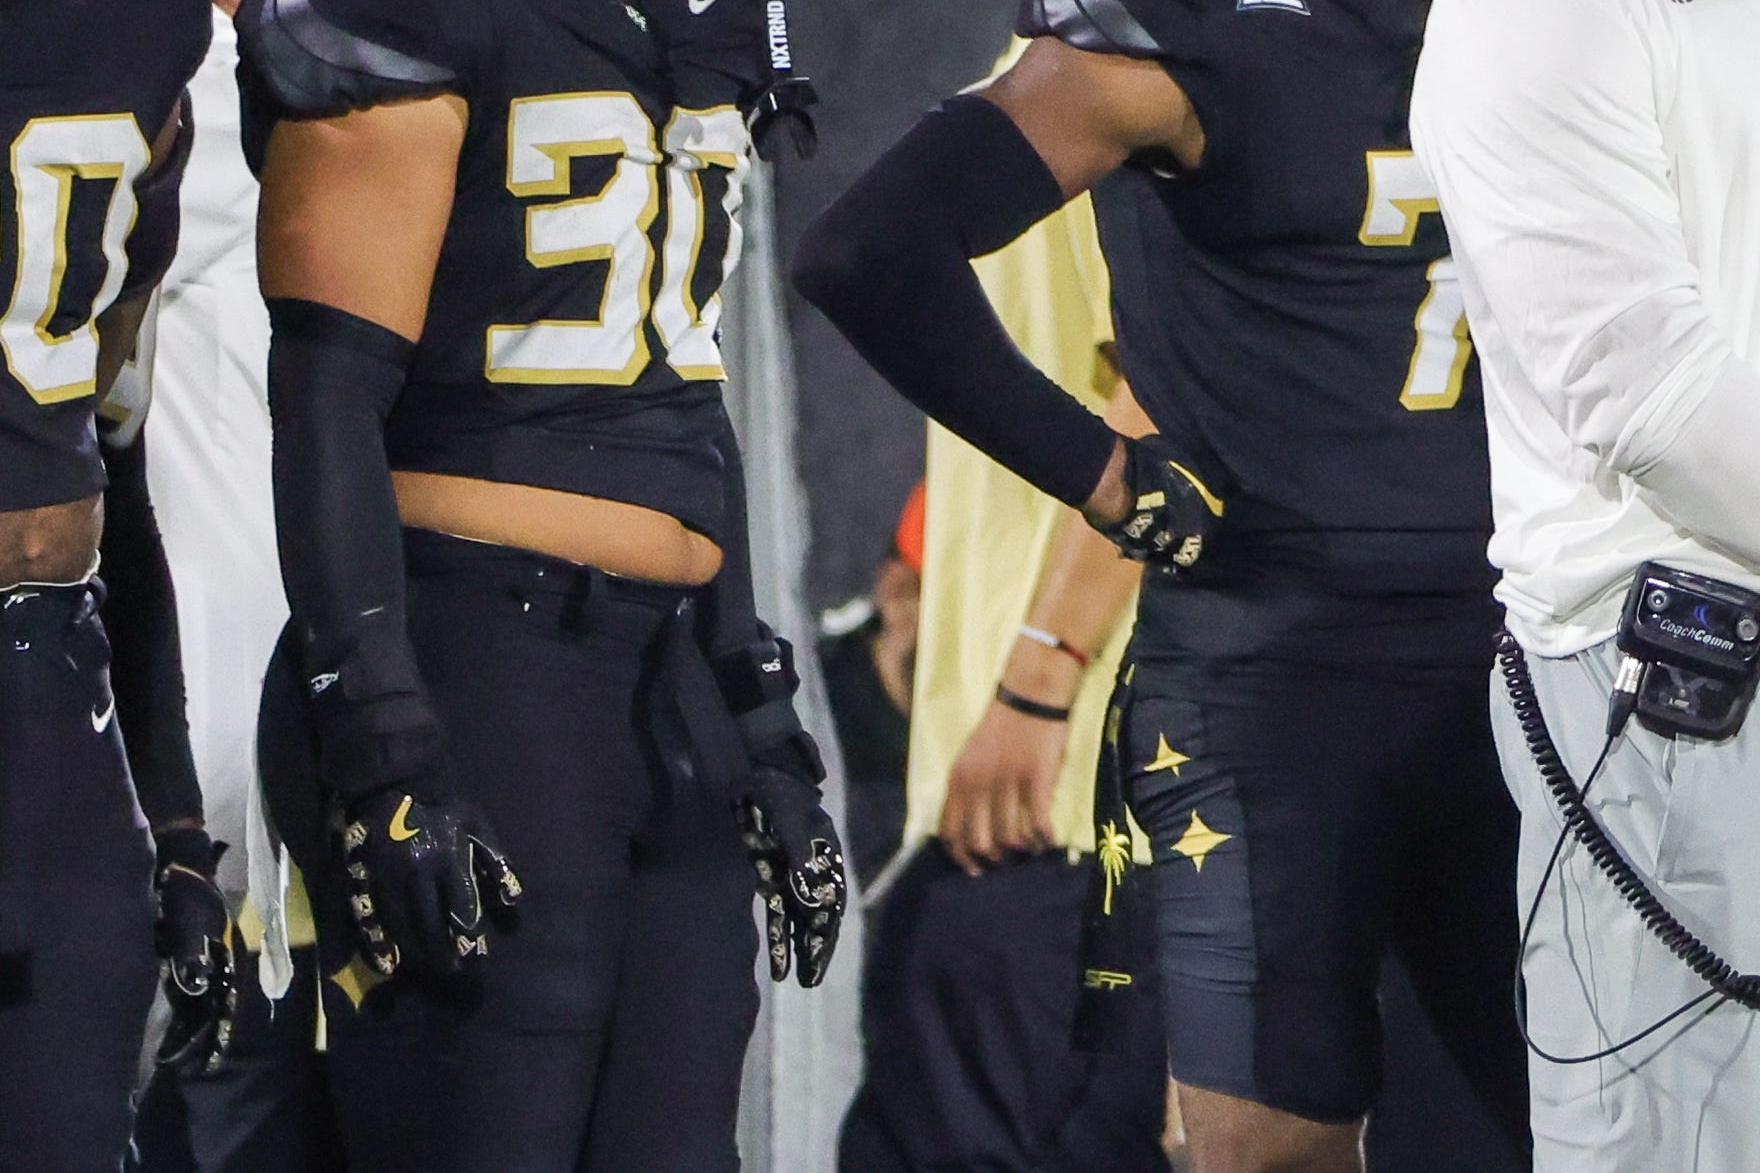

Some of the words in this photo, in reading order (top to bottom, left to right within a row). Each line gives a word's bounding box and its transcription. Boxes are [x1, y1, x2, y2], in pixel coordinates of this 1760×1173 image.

[767, 0, 791, 69] NXTRND
[485, 91, 751, 387] 30
[1358, 150, 1472, 412] 7
[1660, 619, 1734, 652] CoachComm
